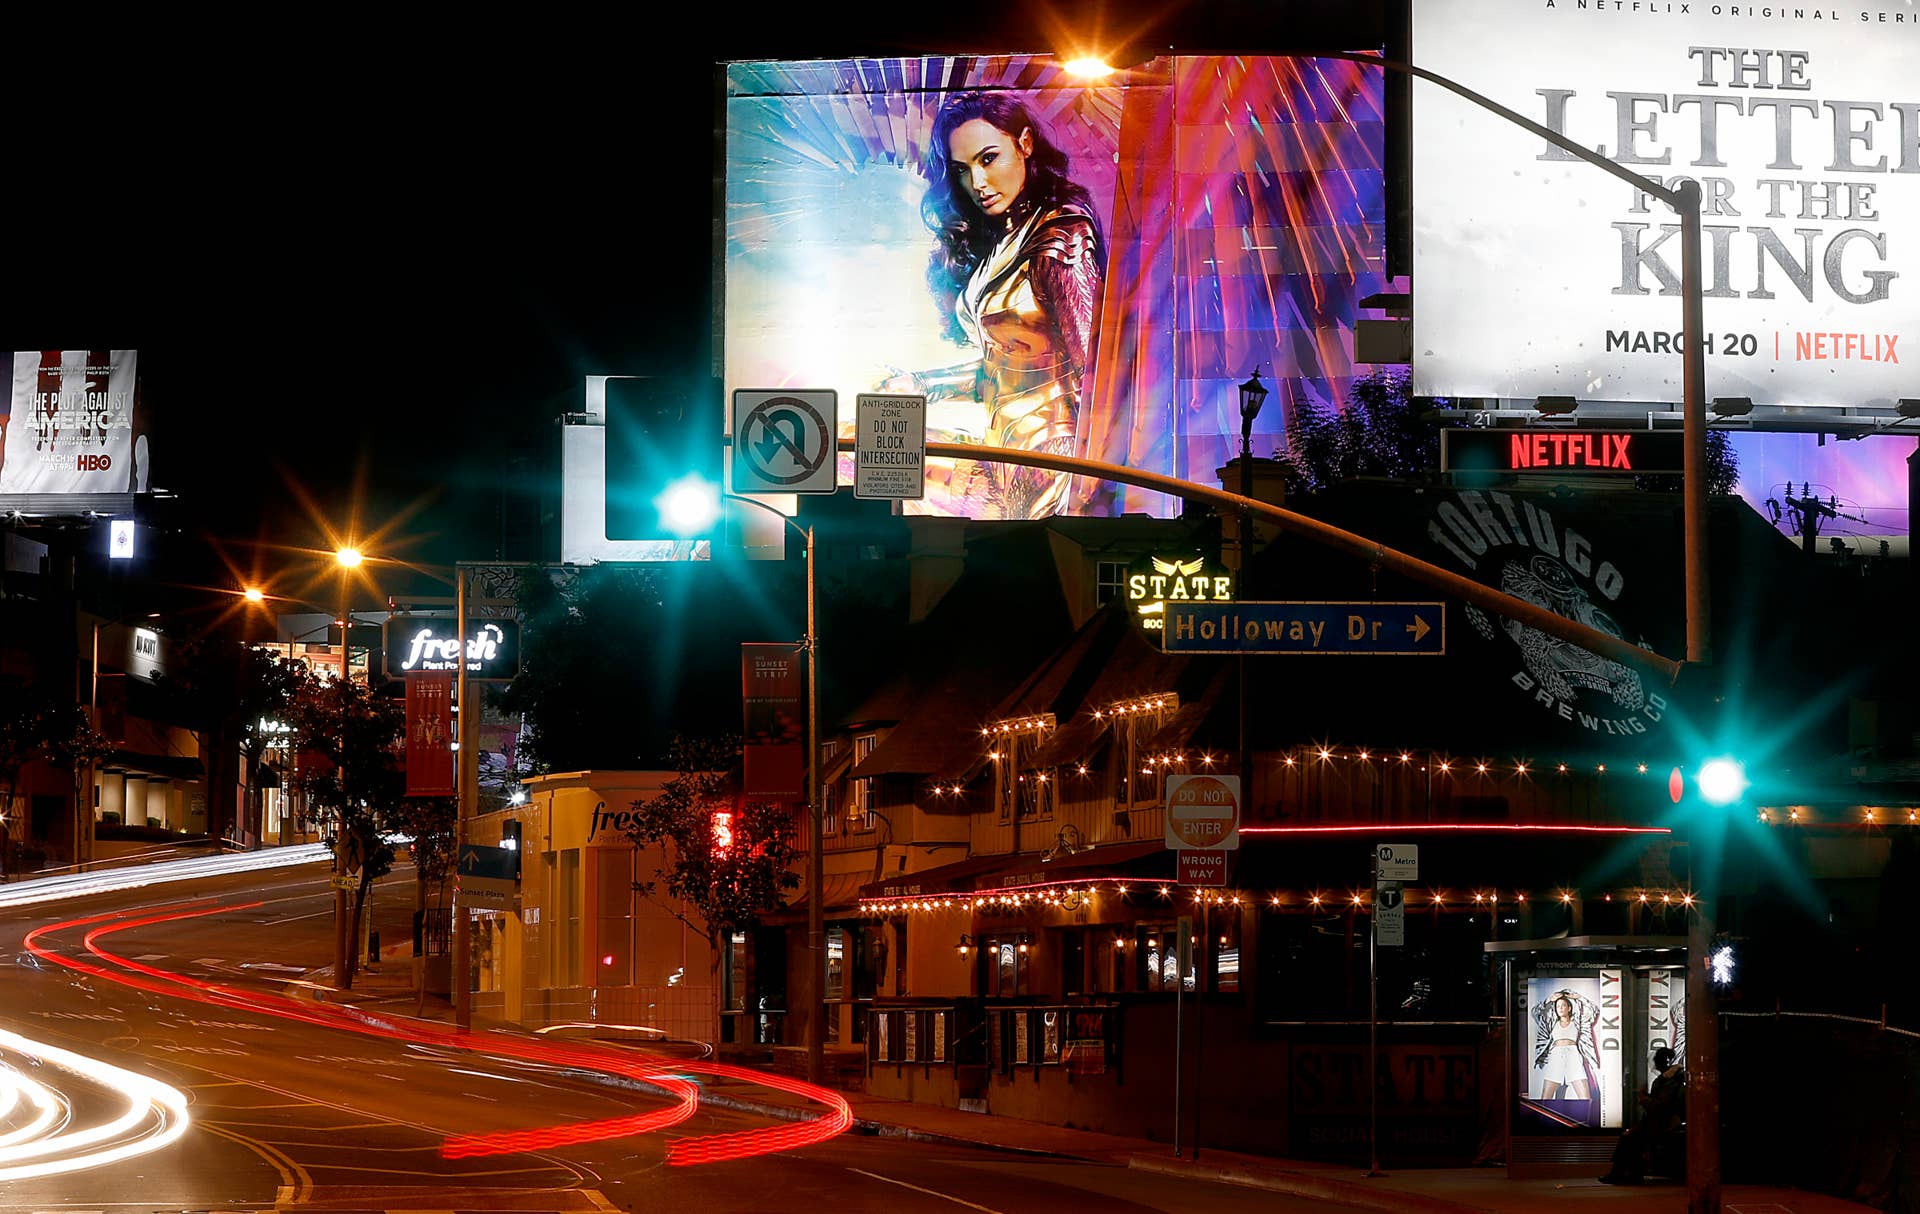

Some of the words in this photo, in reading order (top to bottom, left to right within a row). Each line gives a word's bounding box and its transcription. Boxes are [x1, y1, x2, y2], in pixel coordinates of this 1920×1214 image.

[1577, 0, 1691, 14] NETFLIX
[1711, 4, 1840, 21] ORIGINAL
[1688, 46, 1812, 90] THE
[1756, 179, 1880, 221] THE
[1611, 221, 1899, 304] KING
[1723, 333, 1758, 357] 20
[1795, 332, 1899, 365] NETFLIX
[28, 392, 47, 411] THE
[862, 400, 921, 409] ANTI-GRIDLOCK
[24, 411, 131, 430] AMERICA
[881, 409, 901, 417] ZONE
[1474, 413, 1492, 426] 21
[873, 420, 886, 433] DO
[891, 421, 908, 433] NOT
[876, 436, 904, 449] BLOCK
[1511, 434, 1632, 470] NETFLIX
[77, 455, 111, 471] HBO
[861, 451, 920, 465] INTERSECTION
[1426, 489, 1625, 601] TORTUGO
[1129, 574, 1231, 600] STATE
[1176, 613, 1326, 647] Holloway
[1347, 614, 1383, 640] Dr
[755, 660, 788, 668] SUNSET
[1511, 671, 1647, 736] BREWING
[1642, 692, 1667, 722] CO
[1180, 790, 1196, 802] DO
[1203, 790, 1225, 803] NOT
[1183, 822, 1221, 834] ENTER
[1182, 856, 1222, 865] WRONG
[1189, 870, 1214, 878] WAY
[1378, 869, 1385, 878] 2
[1602, 972, 1620, 1050] DKNY
